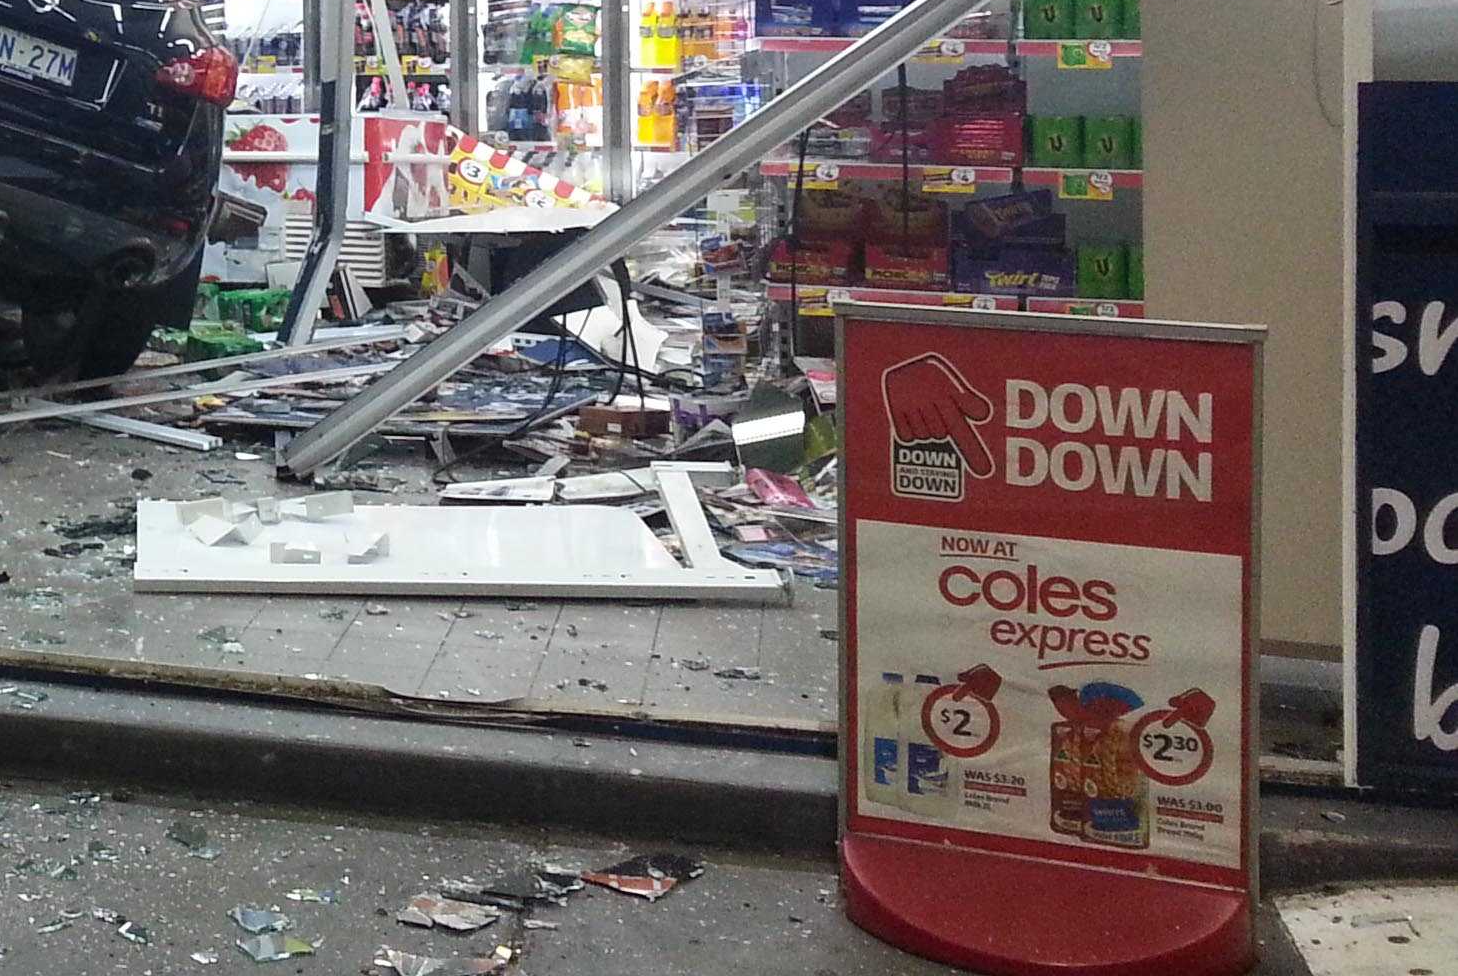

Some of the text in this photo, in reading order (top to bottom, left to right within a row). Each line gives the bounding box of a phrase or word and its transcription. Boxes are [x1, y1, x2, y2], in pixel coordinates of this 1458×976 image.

[1005, 378, 1213, 444] DOWN
[898, 449, 956, 467] DOWN
[1005, 437, 1213, 503] DOWN
[900, 475, 956, 493] DOWN
[941, 535, 1018, 557] NOW AT
[939, 564, 1118, 622] coles
[990, 618, 1152, 661] express
[940, 708, 973, 737] $2
[964, 769, 992, 782] WAS
[1156, 795, 1186, 809] WAS
